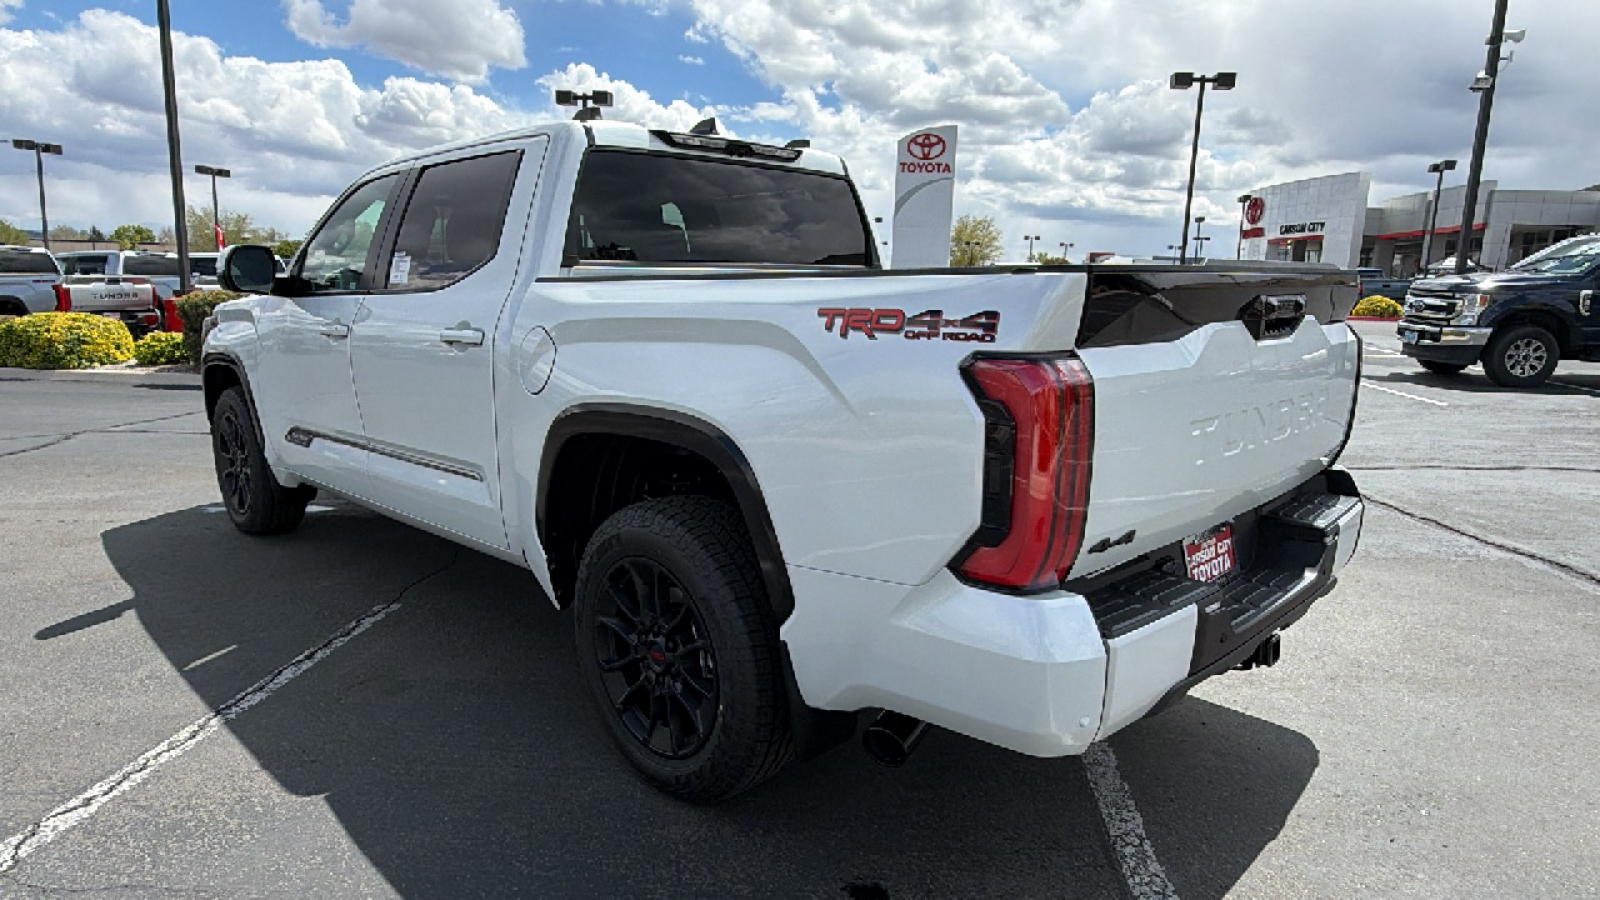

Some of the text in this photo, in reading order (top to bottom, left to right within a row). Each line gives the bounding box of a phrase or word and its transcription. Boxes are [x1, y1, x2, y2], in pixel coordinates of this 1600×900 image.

[900, 162, 951, 173] TOYOTA
[1280, 222, 1325, 235] CARSON CITY
[91, 292, 138, 300] TUNDRA
[818, 307, 906, 340] TRD
[904, 330, 996, 343] OFF ROAD
[1190, 390, 1329, 465] TUNDRA
[1191, 554, 1231, 582] TOYOTA
